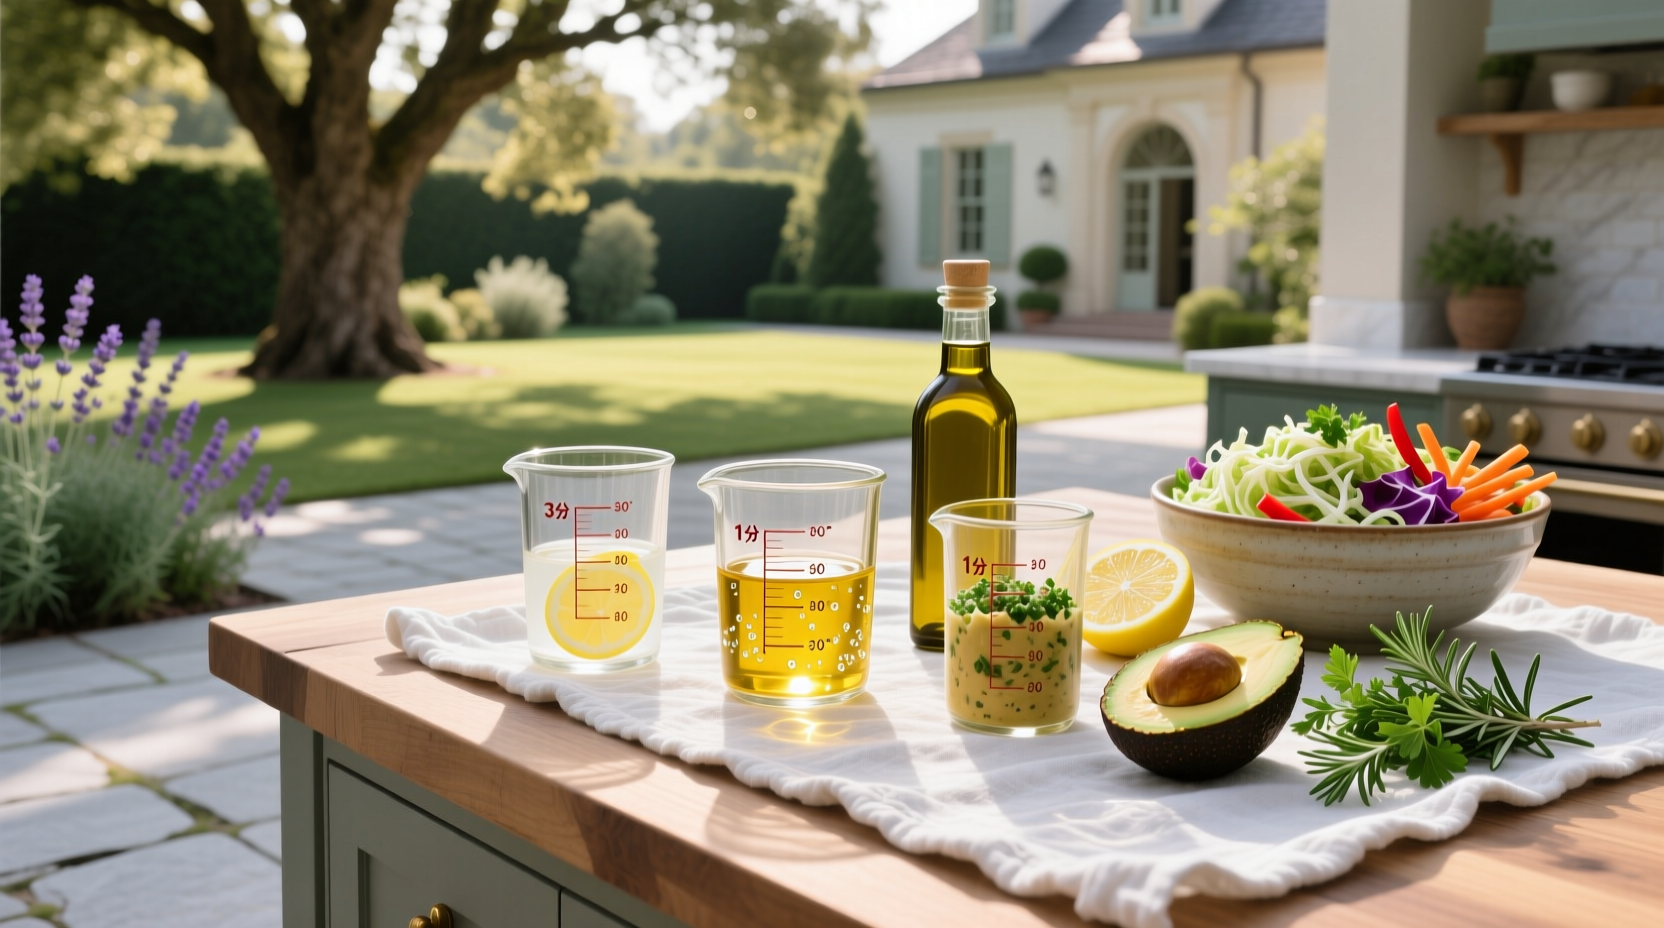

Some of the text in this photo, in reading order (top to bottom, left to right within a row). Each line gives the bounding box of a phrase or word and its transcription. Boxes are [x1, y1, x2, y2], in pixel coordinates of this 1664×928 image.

[544, 502, 569, 519] 3分
[735, 524, 759, 543] 1分
[963, 556, 987, 575] 1分
